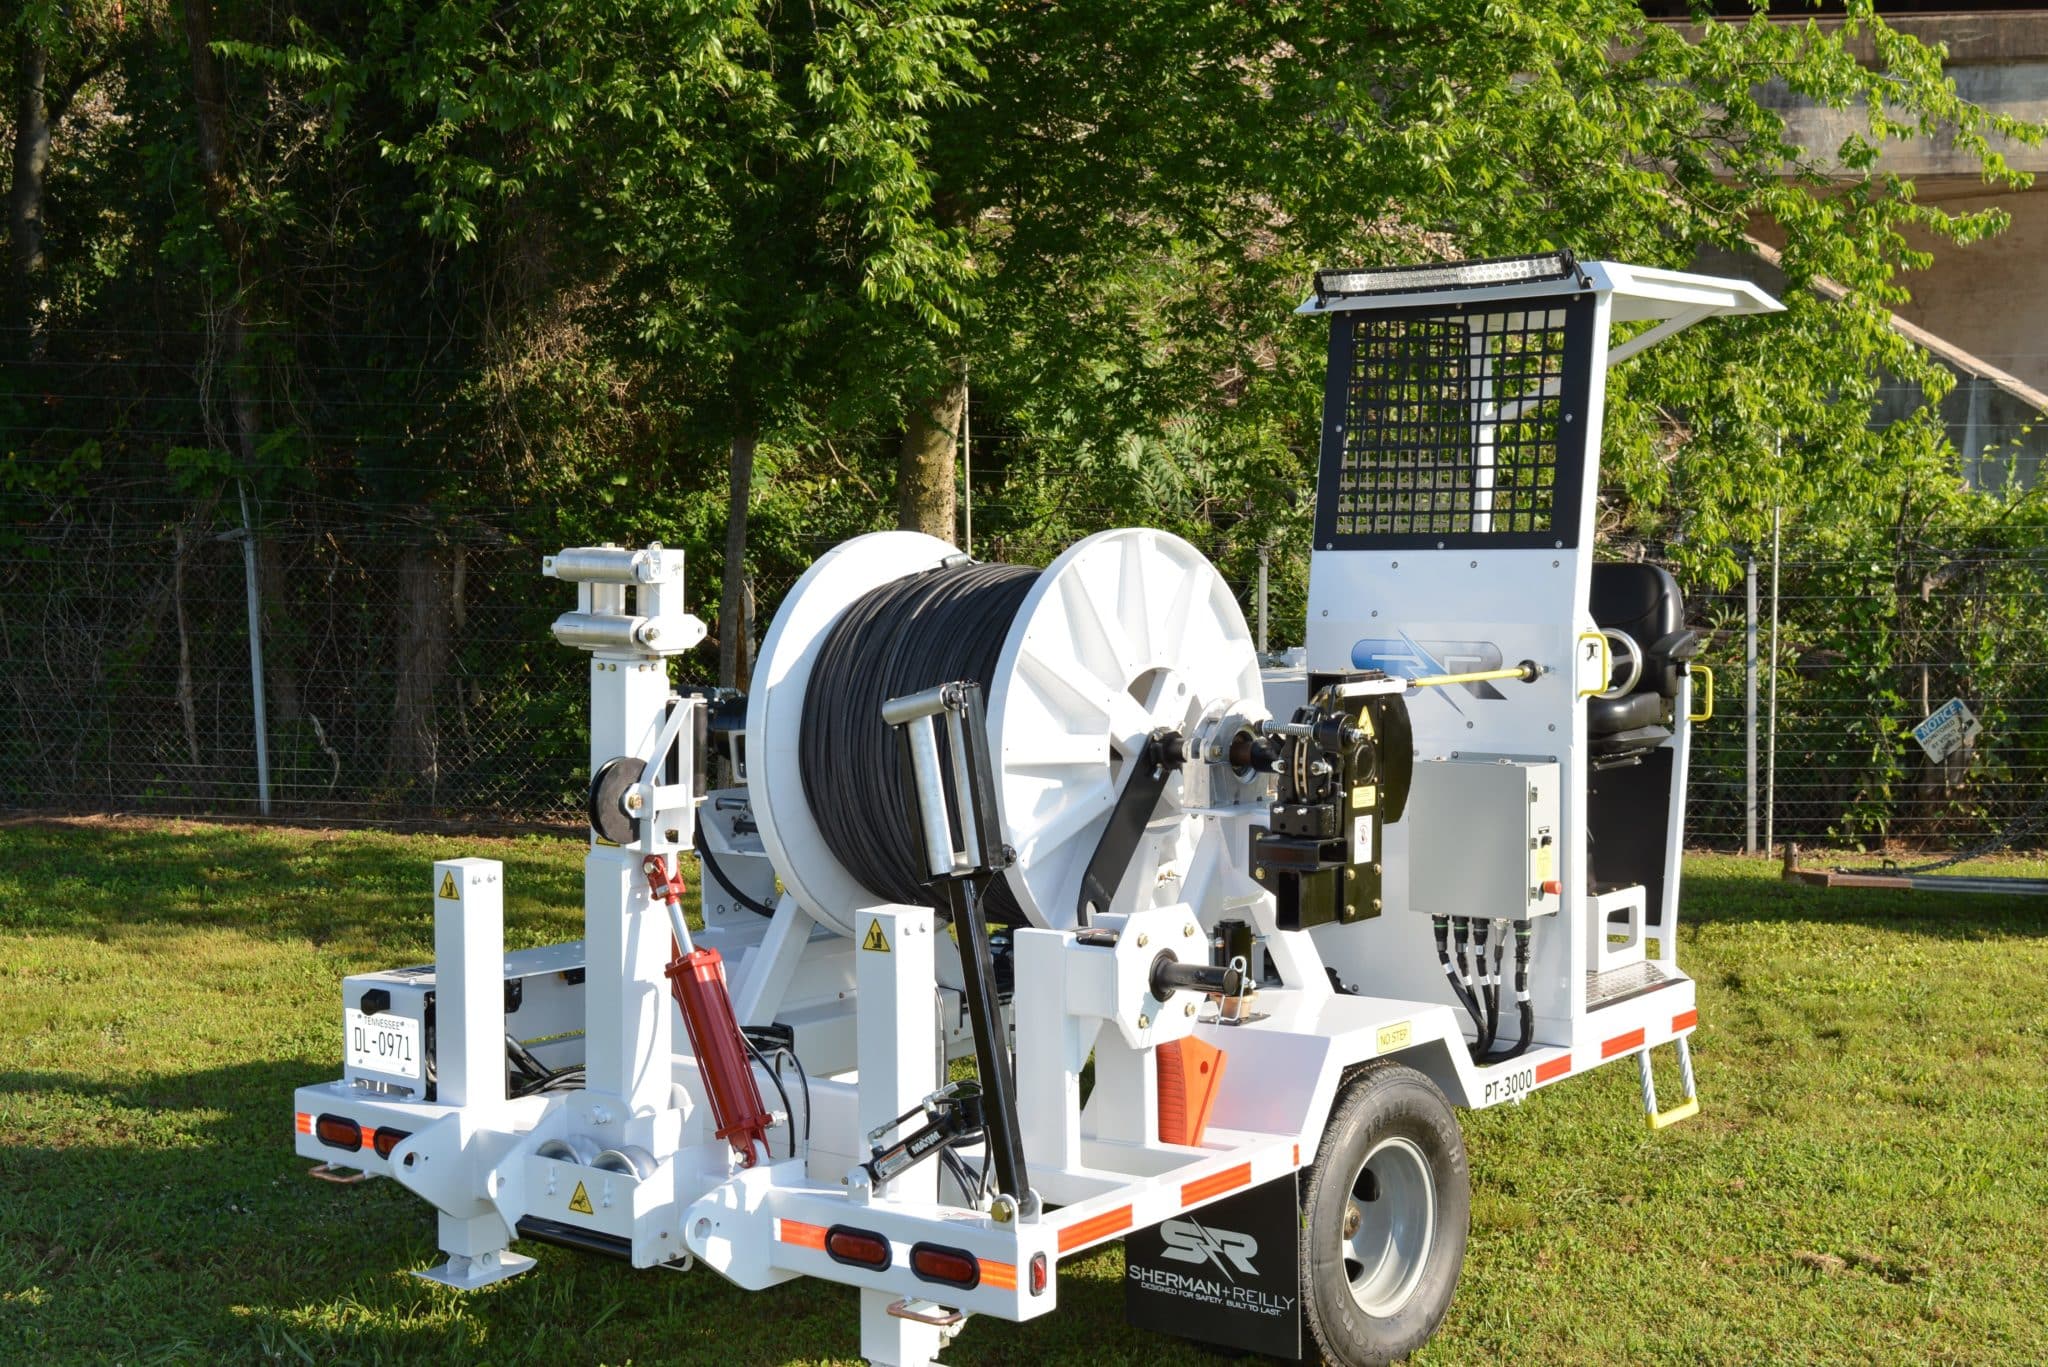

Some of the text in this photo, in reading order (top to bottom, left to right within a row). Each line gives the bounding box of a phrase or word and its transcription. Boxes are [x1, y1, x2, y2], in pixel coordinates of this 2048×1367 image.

[1919, 703, 1957, 737] NOTICE
[1923, 719, 1955, 745] MONITORED
[363, 1015, 400, 1031] TENNESSEE
[1380, 1029, 1408, 1046] NO STEP
[354, 1026, 412, 1062] DL-0971
[1485, 1068, 1532, 1104] PT-3000
[911, 1130, 941, 1155] MAXIM
[1141, 1281, 1177, 1296] DESIGNED
[1178, 1289, 1194, 1300] FOR
[1226, 1299, 1248, 1310] BUILT
[1248, 1304, 1259, 1313] TO
